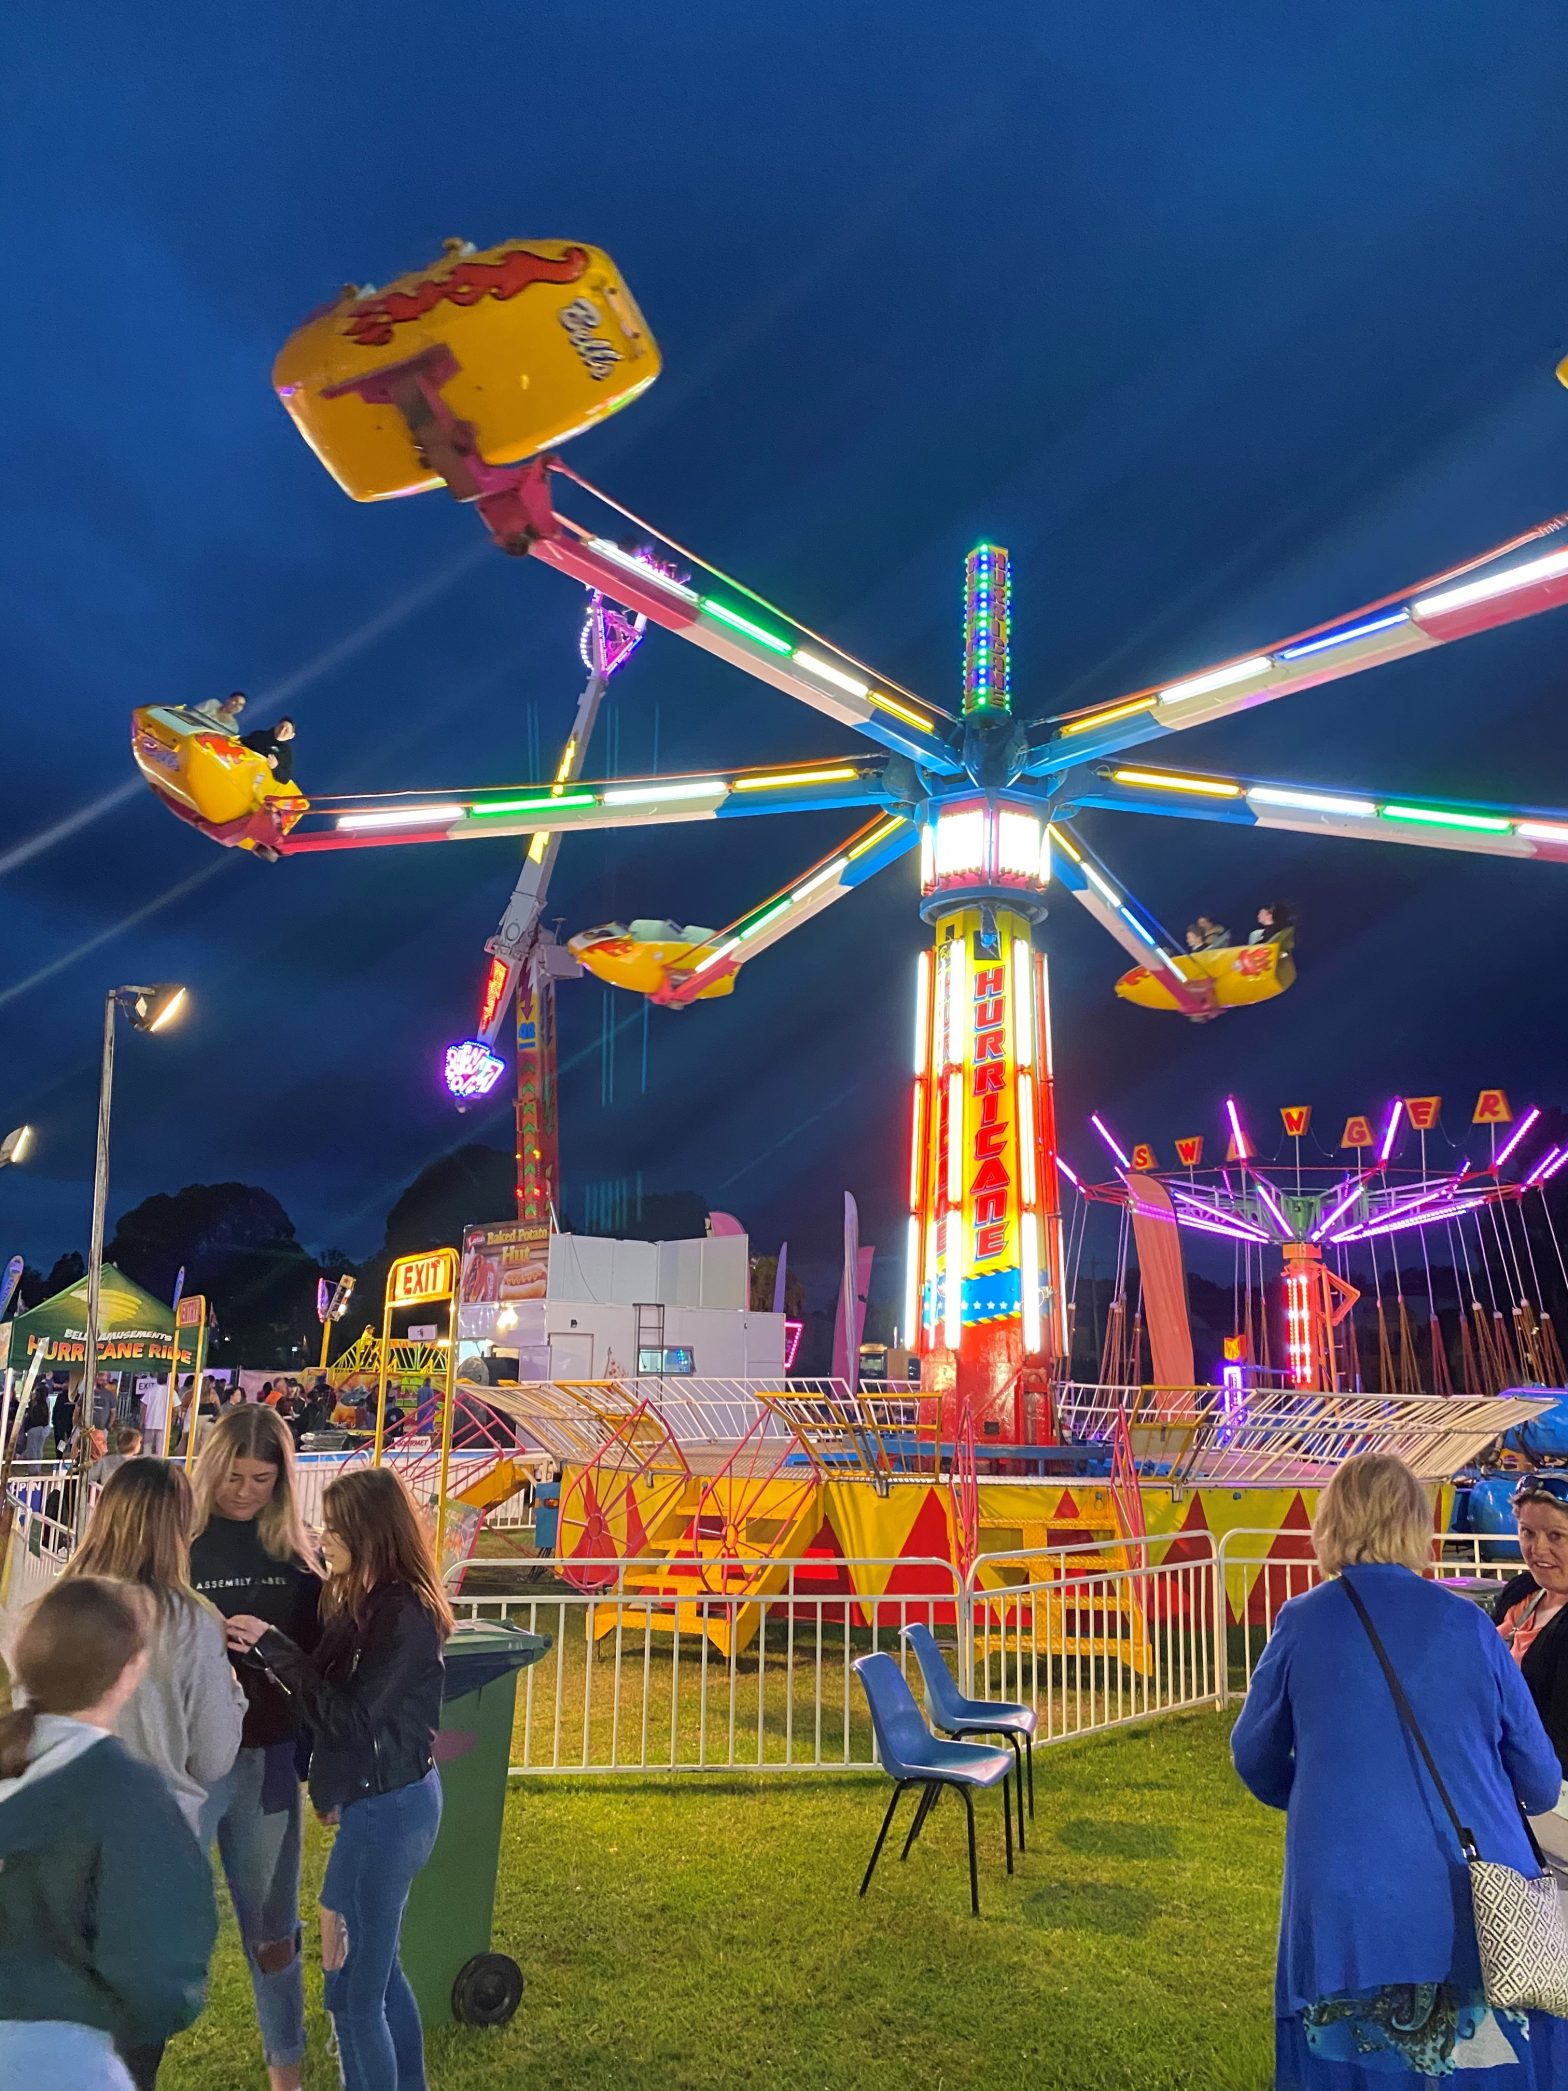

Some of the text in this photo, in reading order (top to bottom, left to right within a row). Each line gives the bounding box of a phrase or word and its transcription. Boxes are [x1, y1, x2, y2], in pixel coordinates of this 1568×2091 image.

[970, 965, 1010, 1262] HURRICANE
[1134, 1094, 1501, 1167] SWNGER
[487, 1229, 516, 1246] Baked
[518, 1227, 548, 1241] Potato
[502, 1245, 530, 1266] Hut
[403, 1257, 441, 1296] EXIT
[98, 1330, 172, 1342] AMUSEMENTS
[27, 1334, 192, 1365] HURRCANE RIDE
[139, 1382, 156, 1391] EXIT
[196, 1577, 251, 1589] ASSEMBLY
